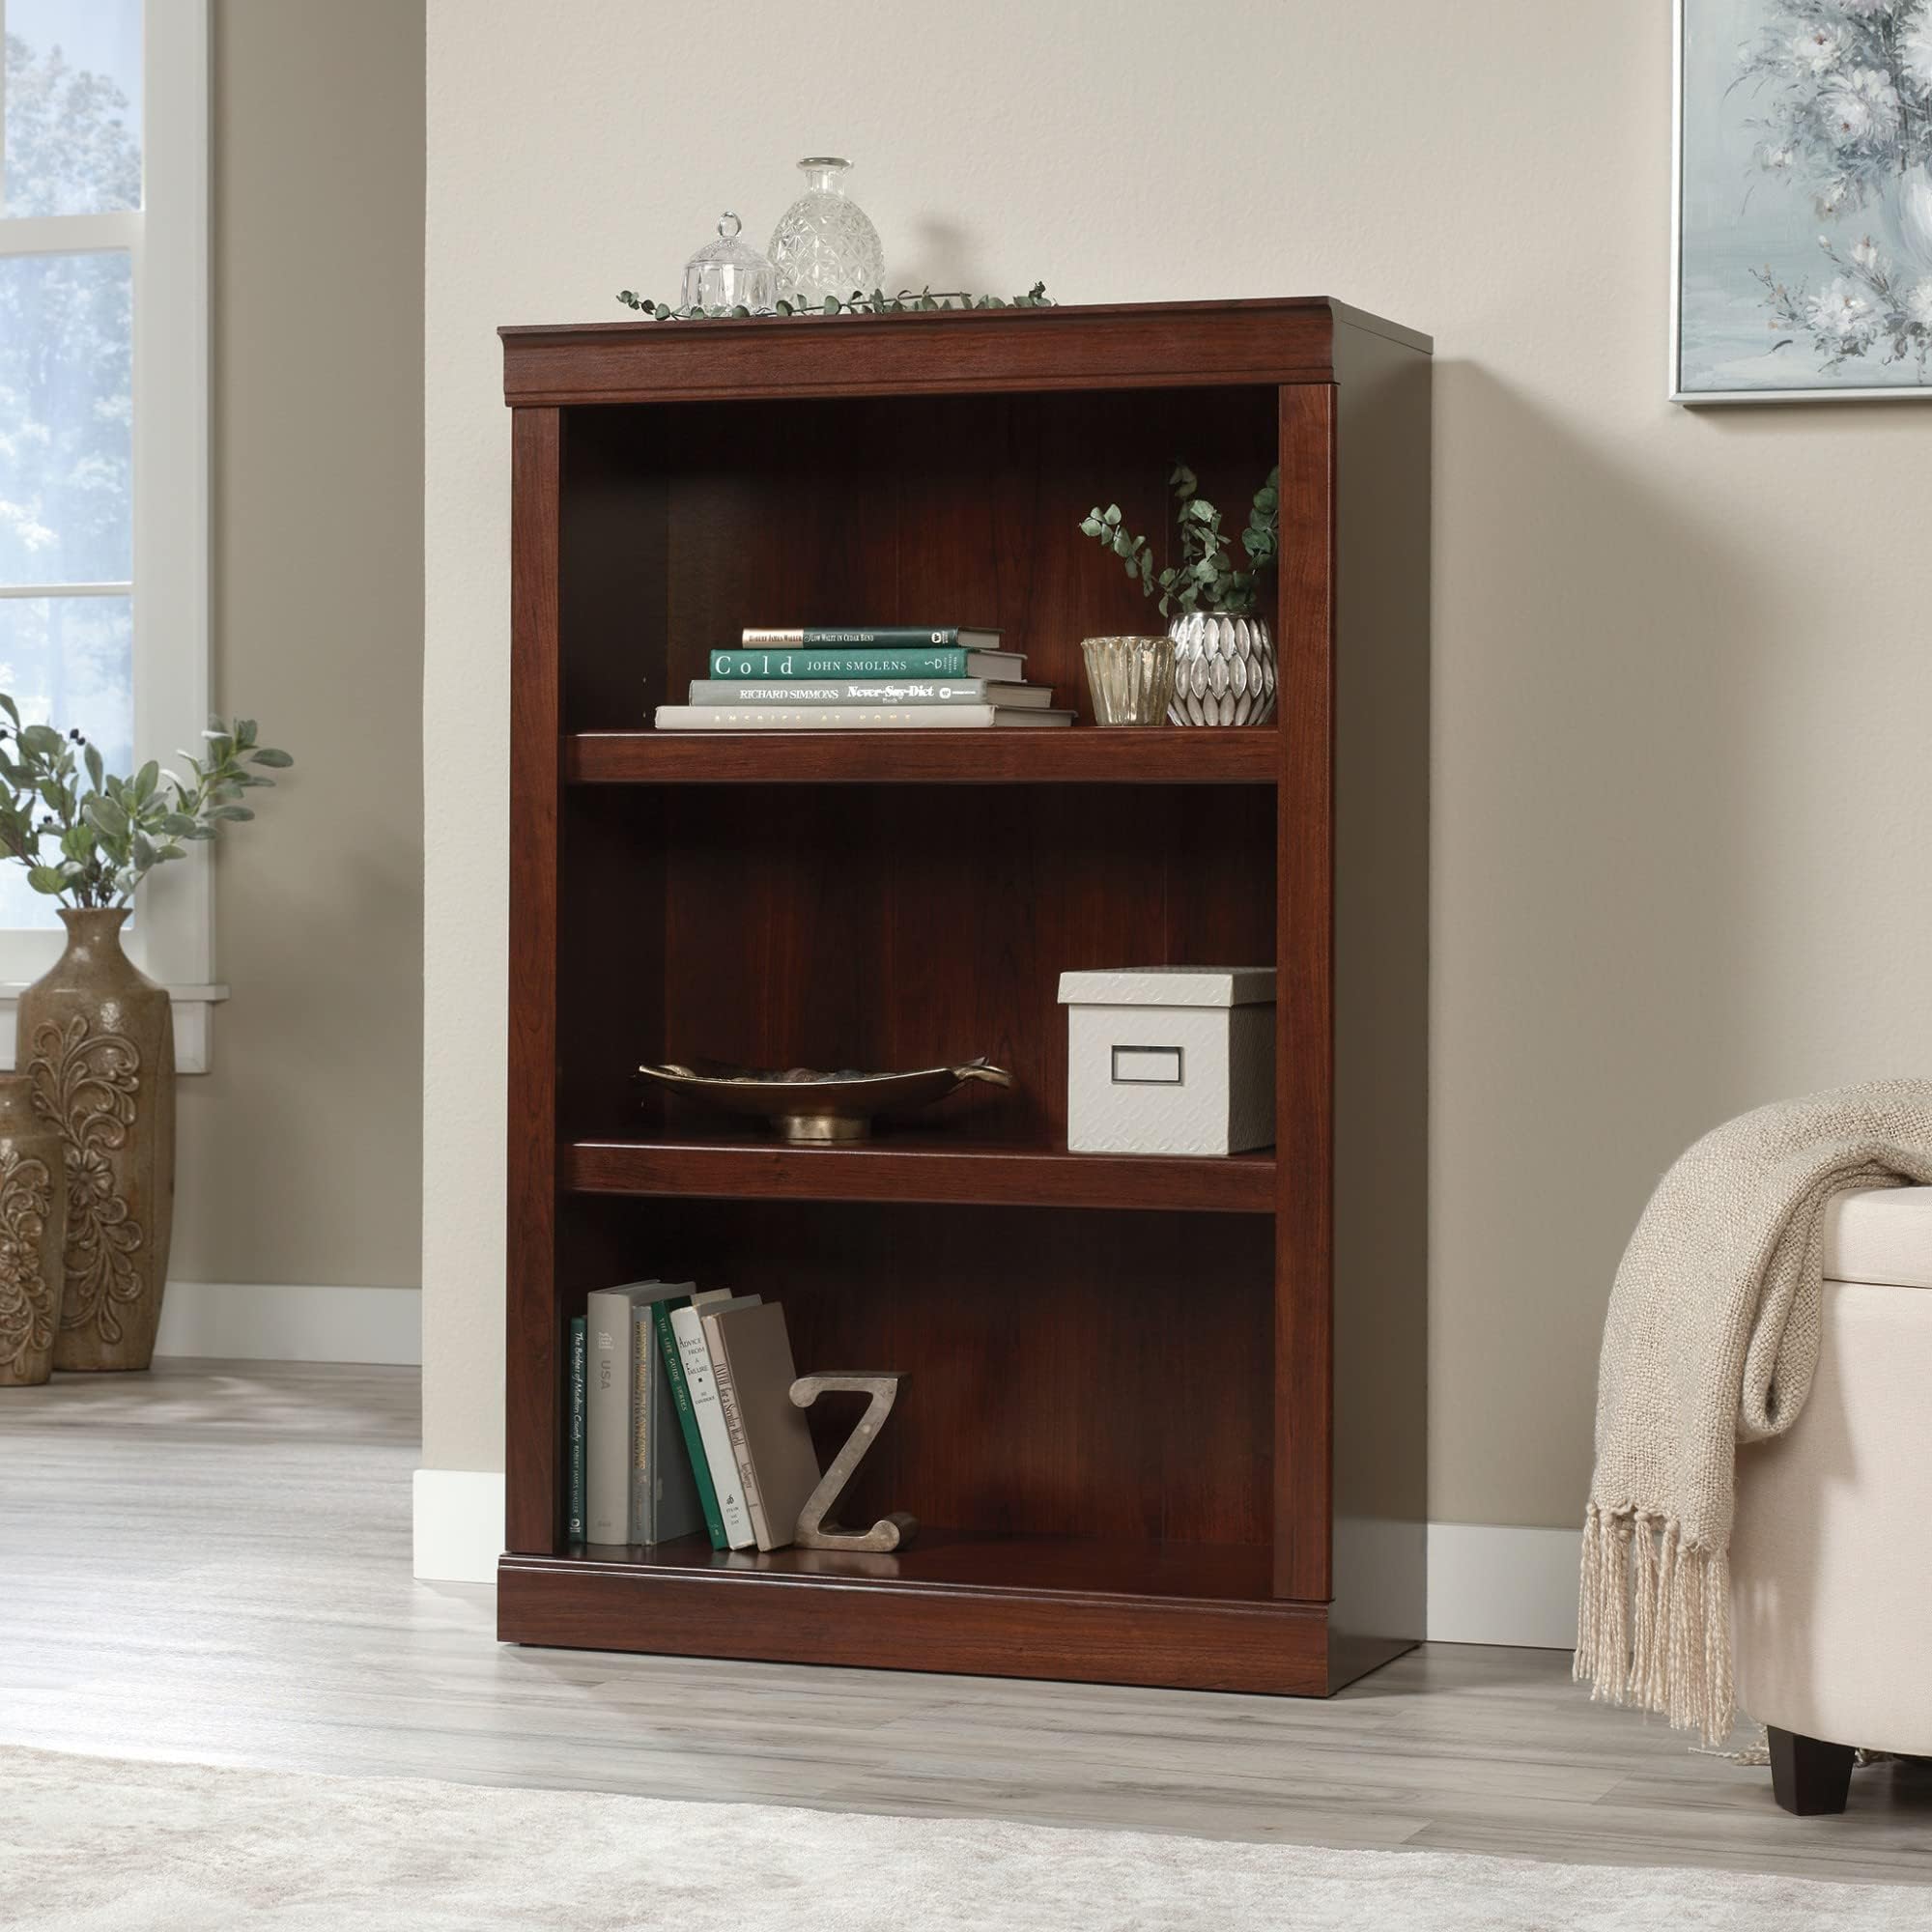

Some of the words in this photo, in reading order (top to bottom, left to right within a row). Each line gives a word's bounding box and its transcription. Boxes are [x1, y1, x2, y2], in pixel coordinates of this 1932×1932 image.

[715, 655, 793, 674] Cold
[807, 662, 841, 670] JOHN
[846, 661, 907, 670] SMOLENS
[740, 689, 788, 699] RICHARD
[789, 689, 839, 699] SIMMONS
[575, 1332, 583, 1346] The
[678, 1336, 701, 1349] ADVICE
[688, 1347, 705, 1355] FROM
[572, 1348, 583, 1373] Bridges
[601, 1359, 611, 1390] USA
[669, 1357, 680, 1381] GUIDE
[572, 1373, 583, 1383] of
[574, 1382, 582, 1413] Madison
[571, 1414, 582, 1442] County
